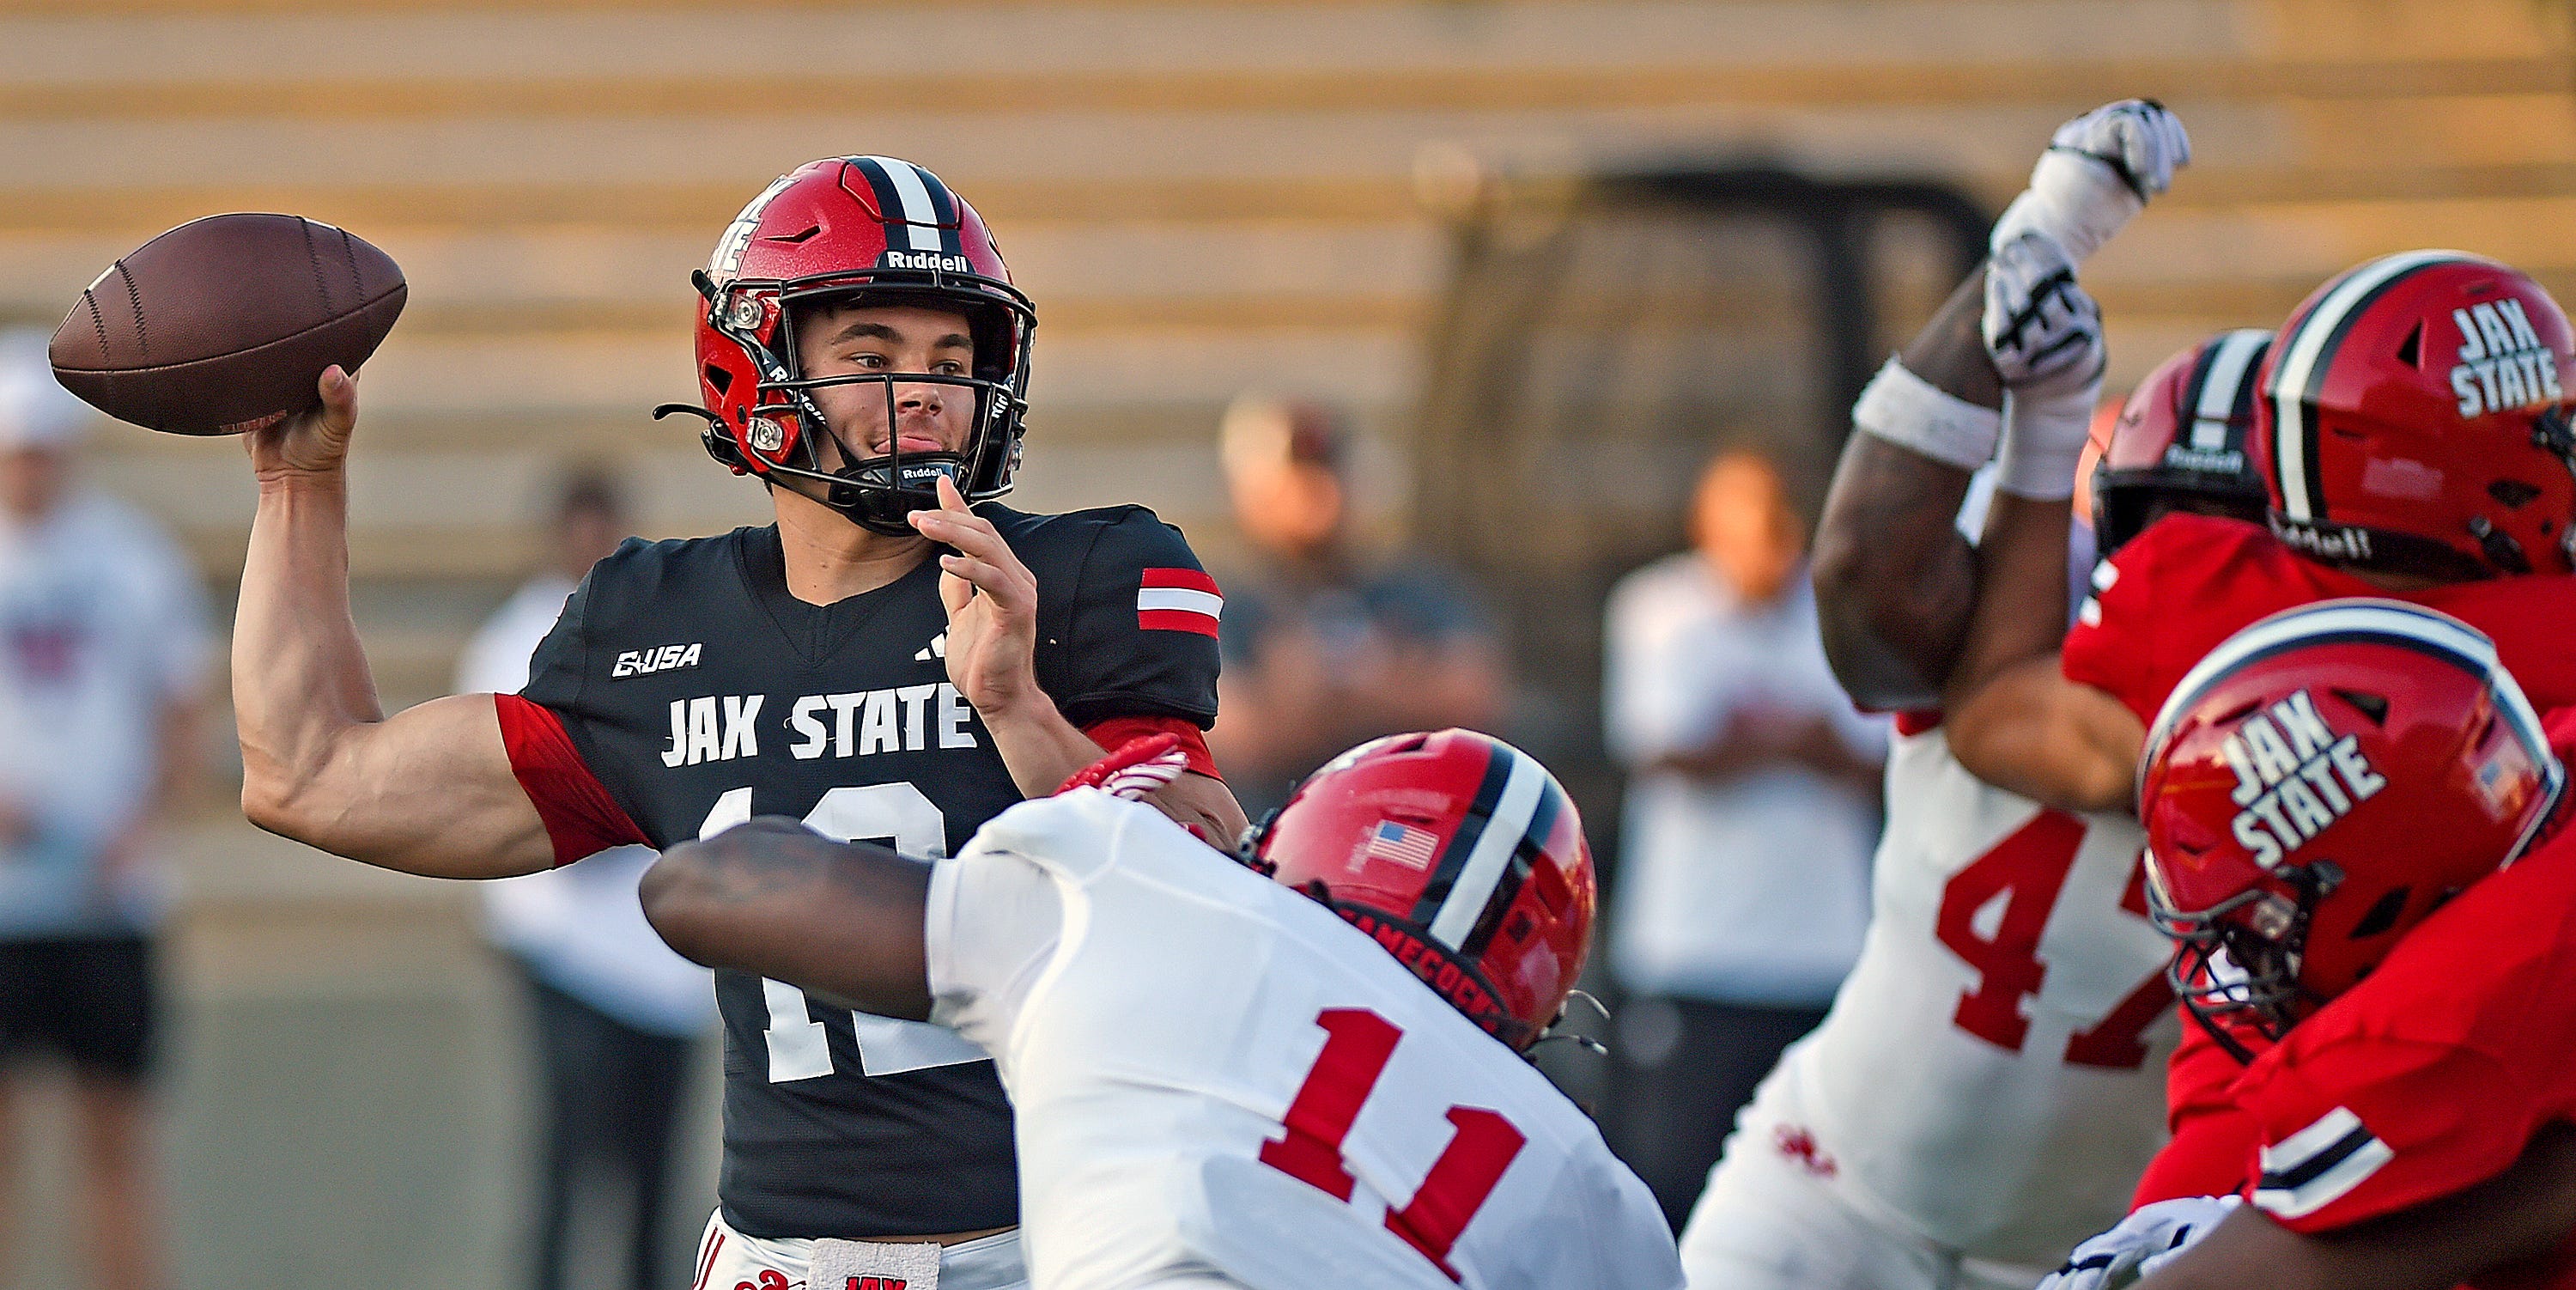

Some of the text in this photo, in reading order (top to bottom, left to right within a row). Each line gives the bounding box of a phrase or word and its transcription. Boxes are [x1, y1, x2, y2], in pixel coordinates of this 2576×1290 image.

[887, 251, 968, 272] Riddell
[2452, 298, 2541, 362] JAX
[2451, 347, 2563, 419] STATE
[902, 467, 943, 479] Riddell
[660, 683, 977, 768] JAX STATE
[2222, 688, 2336, 806] JAX
[2232, 733, 2389, 873] STATE
[1259, 1007, 1528, 1285] 11
